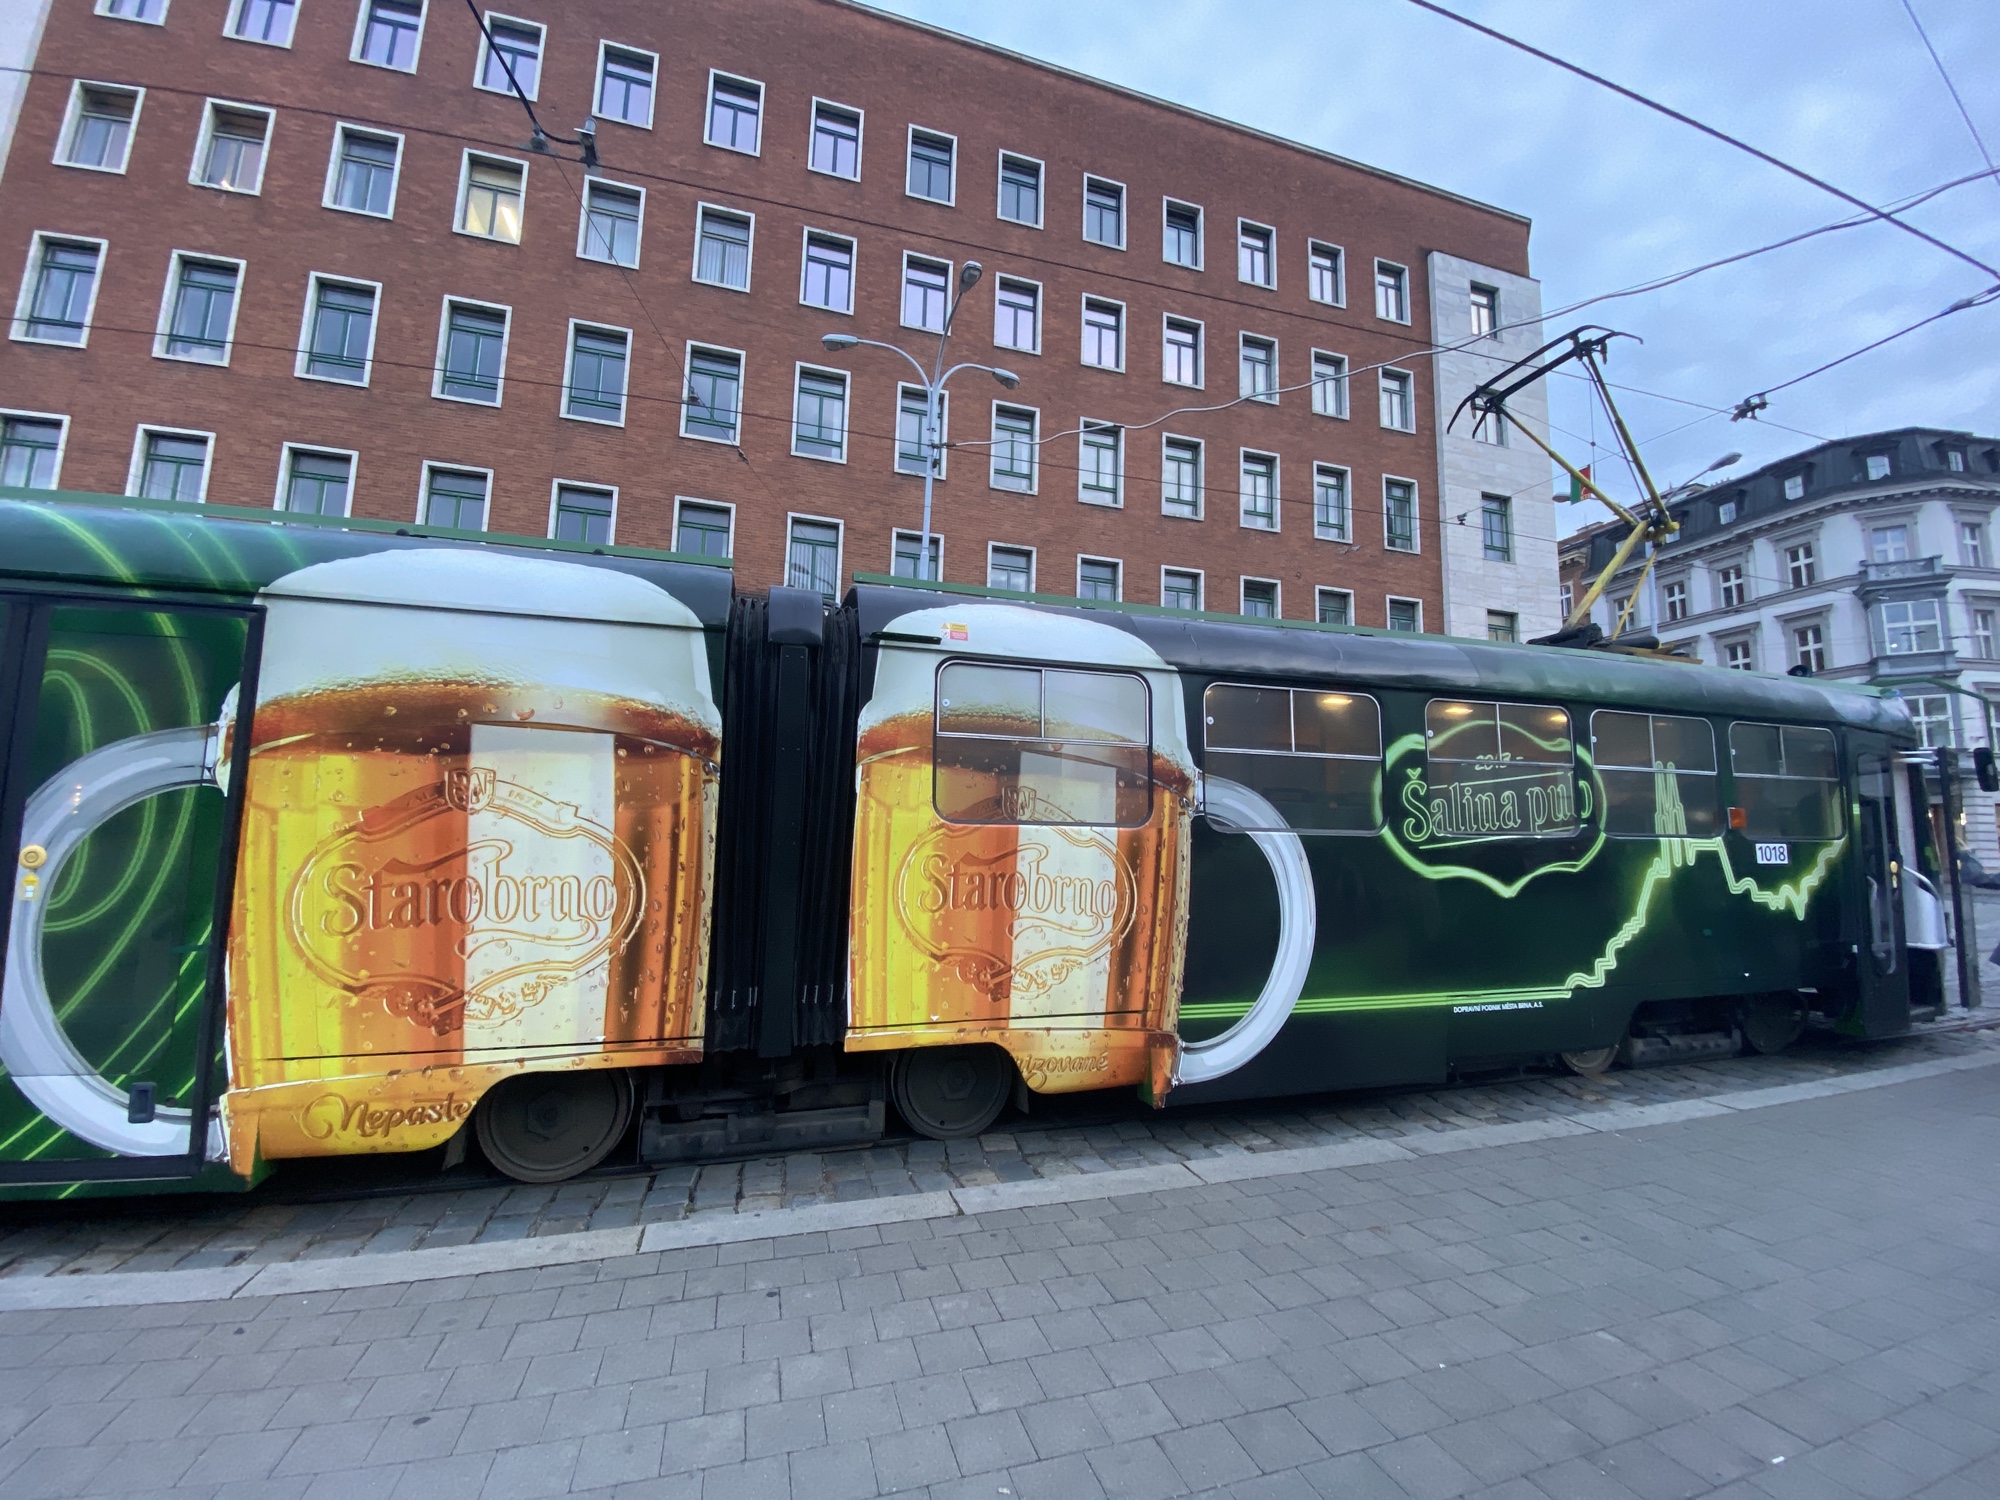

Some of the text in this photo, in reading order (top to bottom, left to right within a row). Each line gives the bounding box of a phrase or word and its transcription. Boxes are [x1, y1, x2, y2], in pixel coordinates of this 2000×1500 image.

[1402, 767, 1594, 843] Šalina pub
[1757, 845, 1786, 862] 1018
[320, 838, 619, 960] Starobrno
[917, 842, 1118, 940] Starobrno
[1453, 1003, 1481, 1014] DOPRAVNÍ
[1481, 1003, 1502, 1012] PODNIK
[1502, 1001, 1518, 1010] MĚSTA
[300, 1091, 480, 1140] Nepaste
